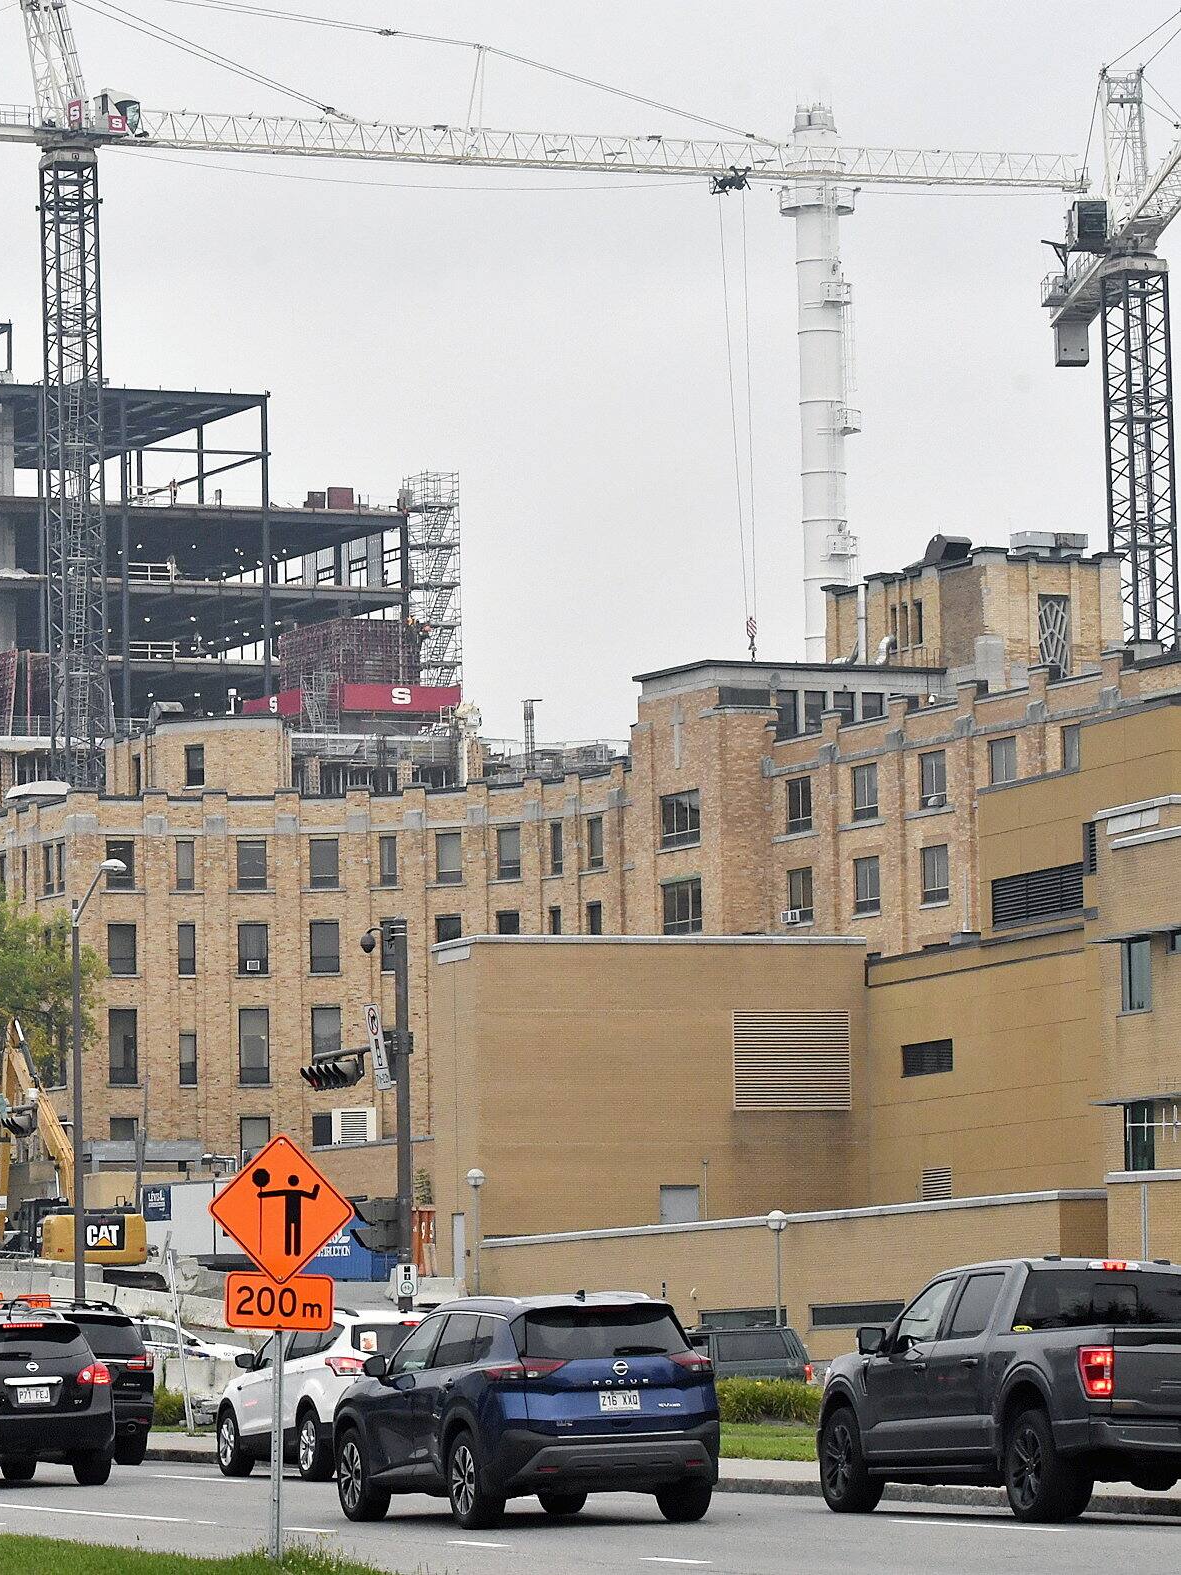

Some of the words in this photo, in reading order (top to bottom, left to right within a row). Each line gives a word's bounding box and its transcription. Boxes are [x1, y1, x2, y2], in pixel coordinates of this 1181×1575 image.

[111, 118, 123, 128] S
[269, 696, 278, 713] S
[391, 687, 412, 705] S
[86, 1225, 119, 1246] CAT
[236, 1285, 297, 1318] 200
[302, 1302, 323, 1319] m
[592, 1378, 650, 1386] ROGUE
[601, 1395, 618, 1406] Z16
